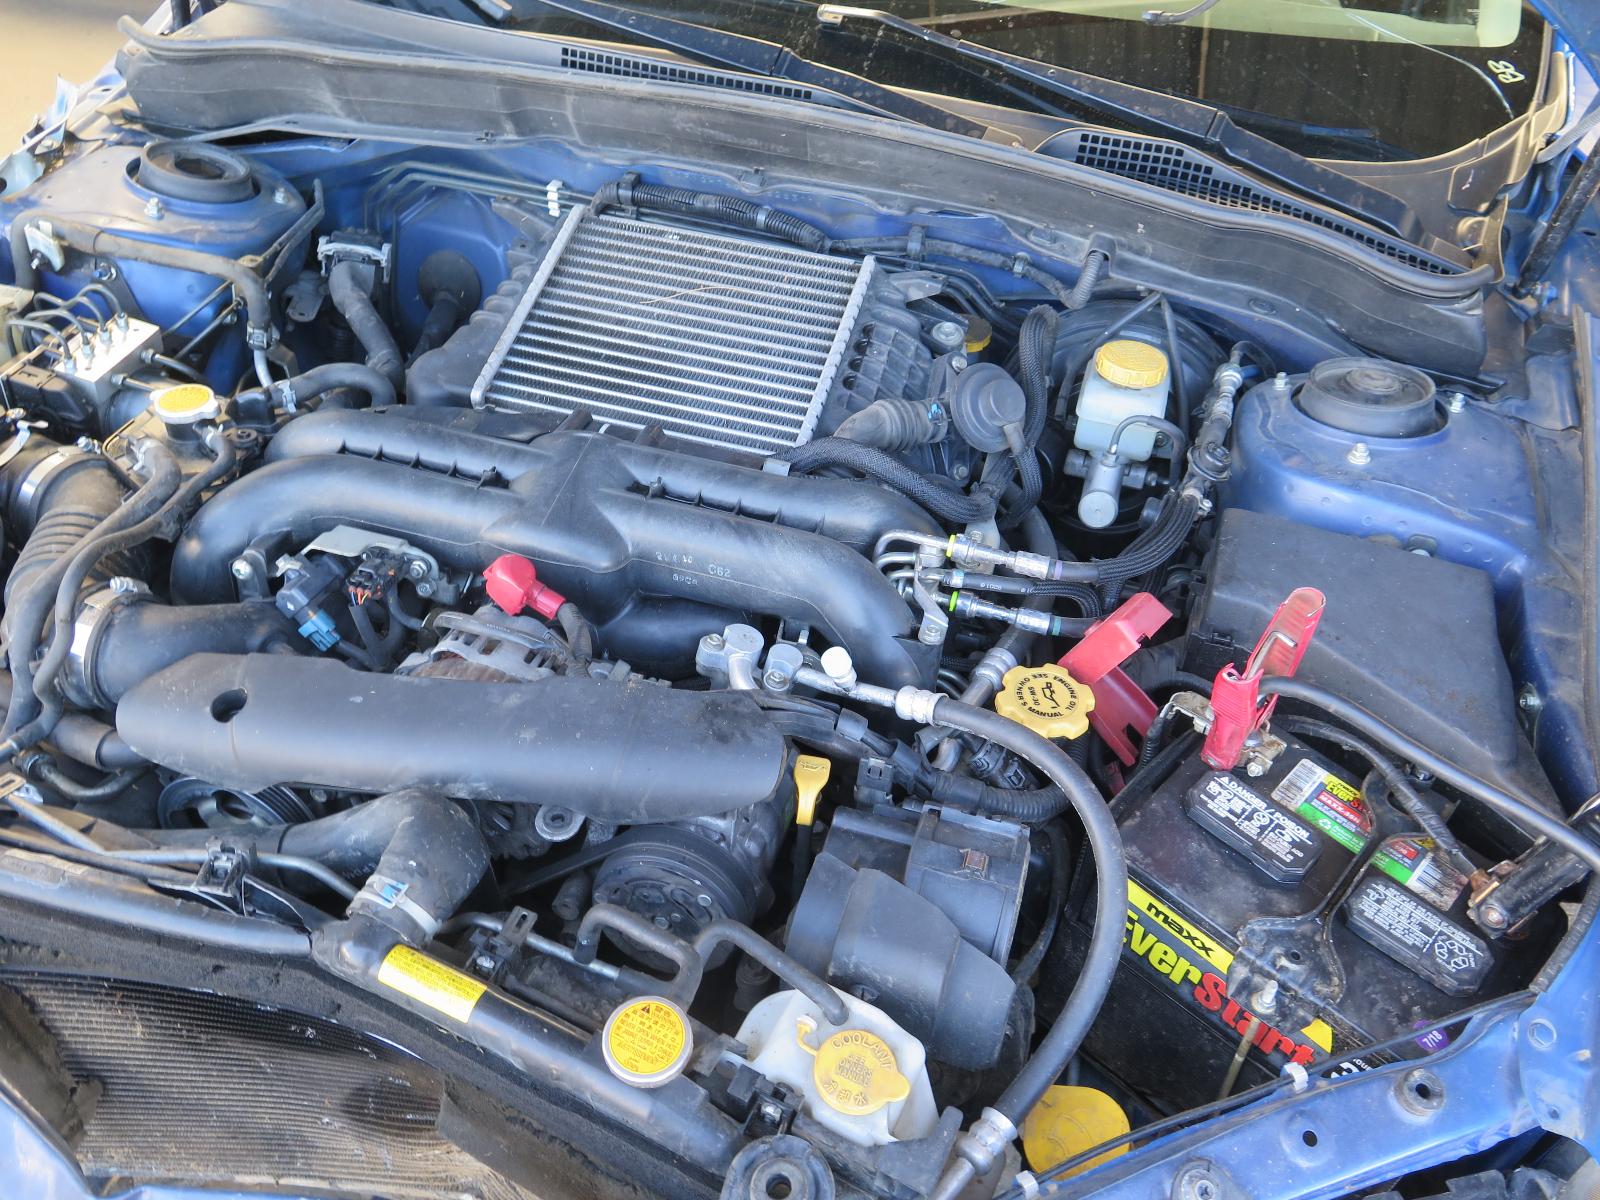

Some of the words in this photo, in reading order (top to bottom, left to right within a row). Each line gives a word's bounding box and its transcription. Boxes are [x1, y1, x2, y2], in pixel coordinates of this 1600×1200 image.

[1028, 686, 1041, 706] 5W-30
[1053, 675, 1077, 699] ENGINE
[1065, 702, 1076, 711] OIL
[1028, 706, 1064, 718] MANUAL
[1228, 780, 1268, 810] DANGER
[1273, 811, 1311, 841] POISON
[1147, 902, 1215, 959] maxx
[832, 1032, 893, 1071] COOLANT
[1422, 1030, 1443, 1048] 7/18
